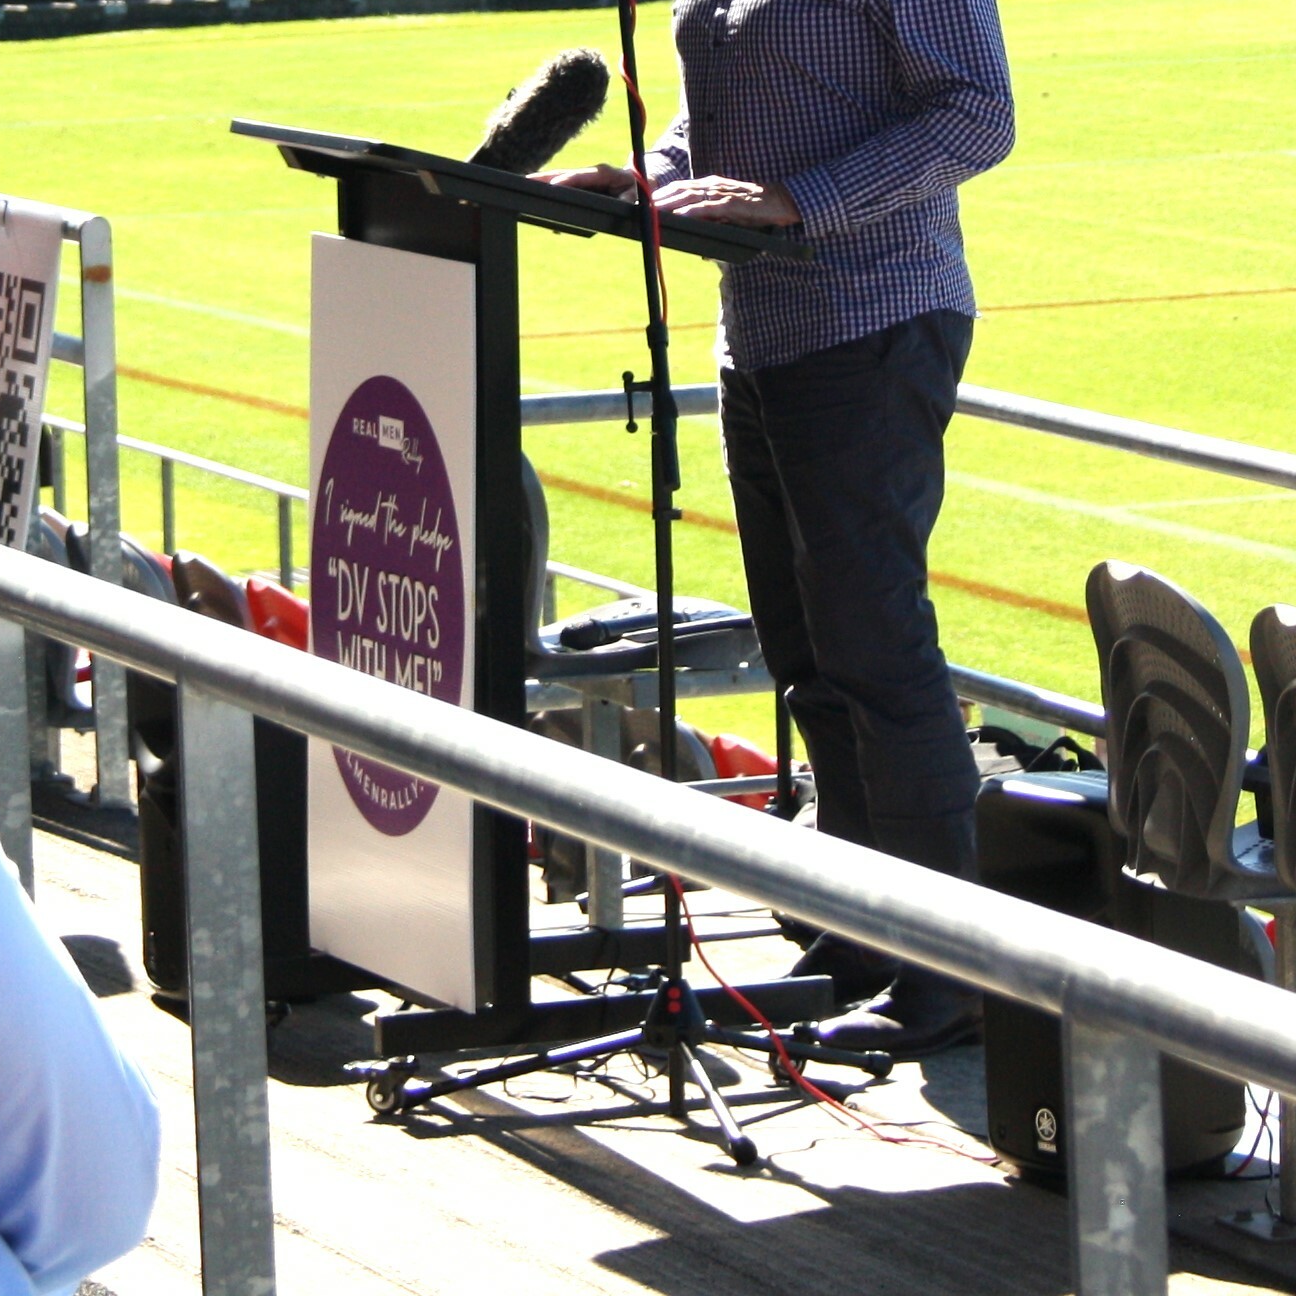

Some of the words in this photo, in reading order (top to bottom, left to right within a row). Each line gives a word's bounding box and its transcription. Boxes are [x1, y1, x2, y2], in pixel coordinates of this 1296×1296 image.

[353, 417, 378, 439] REAL
[381, 423, 402, 441] MEN
[340, 490, 382, 547] signed
[380, 493, 407, 545] the
[409, 496, 454, 573] pledge
[376, 570, 440, 650] STOPS
[337, 630, 386, 682] WITH
